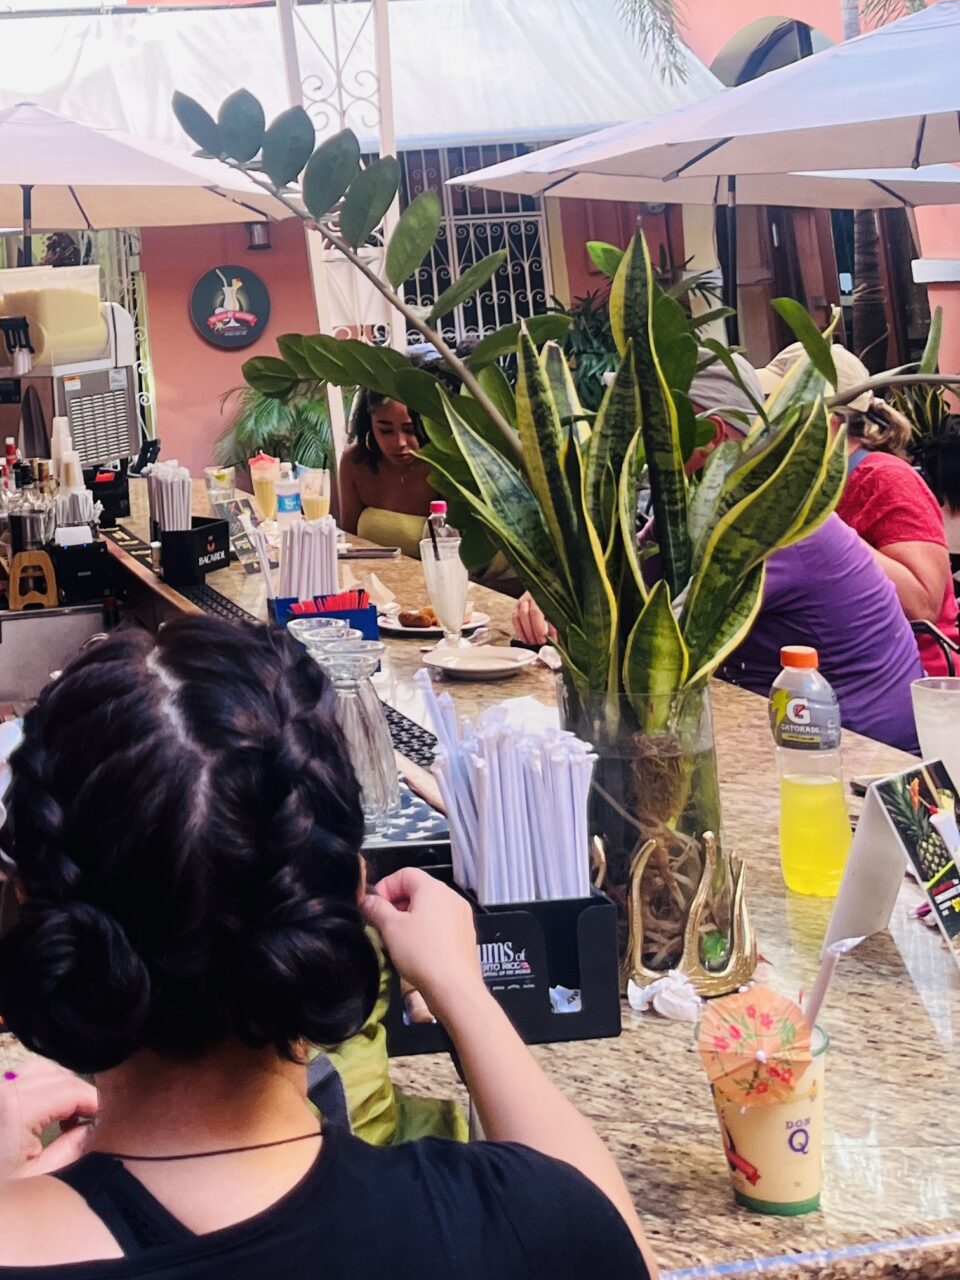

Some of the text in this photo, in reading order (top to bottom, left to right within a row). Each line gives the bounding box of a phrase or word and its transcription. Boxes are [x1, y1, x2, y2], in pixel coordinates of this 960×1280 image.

[786, 698, 810, 724] G
[476, 942, 526, 964] ums of
[785, 1117, 811, 1129] DON
[788, 1128, 809, 1155] Q
